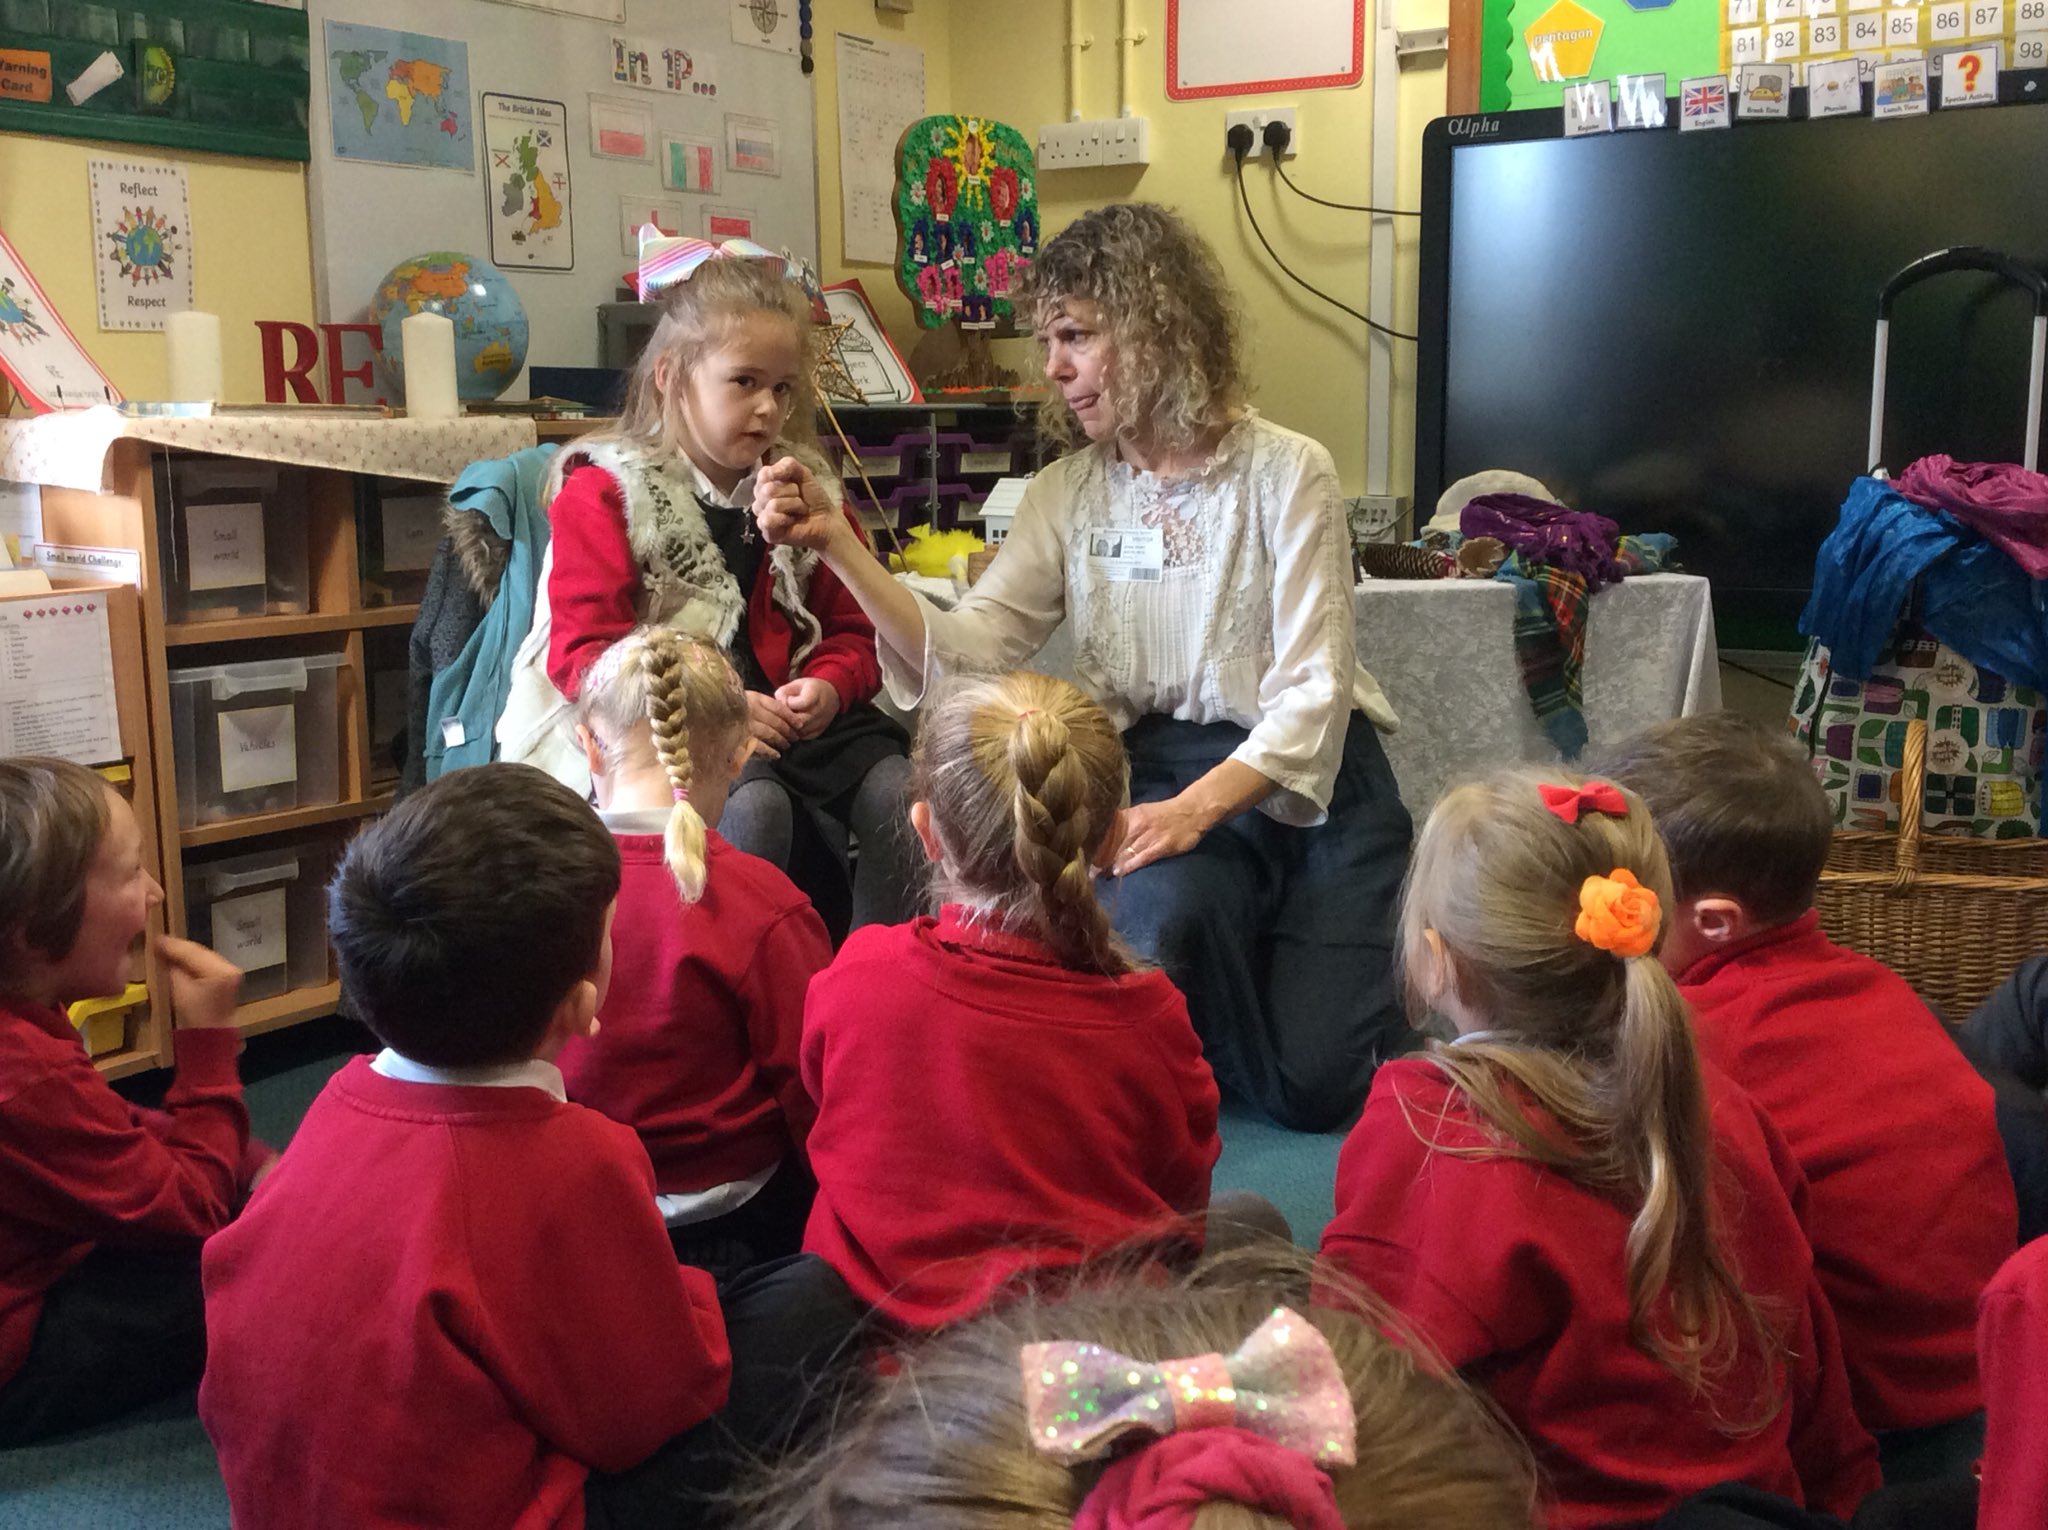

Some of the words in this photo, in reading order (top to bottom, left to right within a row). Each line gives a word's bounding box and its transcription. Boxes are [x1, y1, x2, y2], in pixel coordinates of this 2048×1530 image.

[1737, 37, 1755, 53] 81
[1775, 31, 1795, 48] 82
[1814, 26, 1836, 43] 83
[1856, 21, 1877, 39] 84
[1891, 17, 1913, 35] 85
[1936, 11, 1960, 30] 86
[1975, 7, 1999, 25] 87
[2021, 2, 2045, 20] 88
[2020, 42, 2043, 59] 98
[613, 38, 652, 85] In
[1, 78, 33, 93] Card
[1944, 95, 1967, 104] Special
[1969, 93, 1994, 102] Activity
[498, 102, 510, 112] The
[512, 104, 534, 115] British
[536, 107, 552, 117] Isles
[1883, 104, 1902, 113] Lunch
[1694, 119, 1716, 128] English
[120, 182, 158, 198] Reflect
[127, 295, 166, 309] Respect
[254, 321, 388, 405] RE
[213, 529, 237, 541] Small
[47, 551, 65, 561] Small
[66, 553, 86, 563] world
[240, 739, 276, 753] Vehicles
